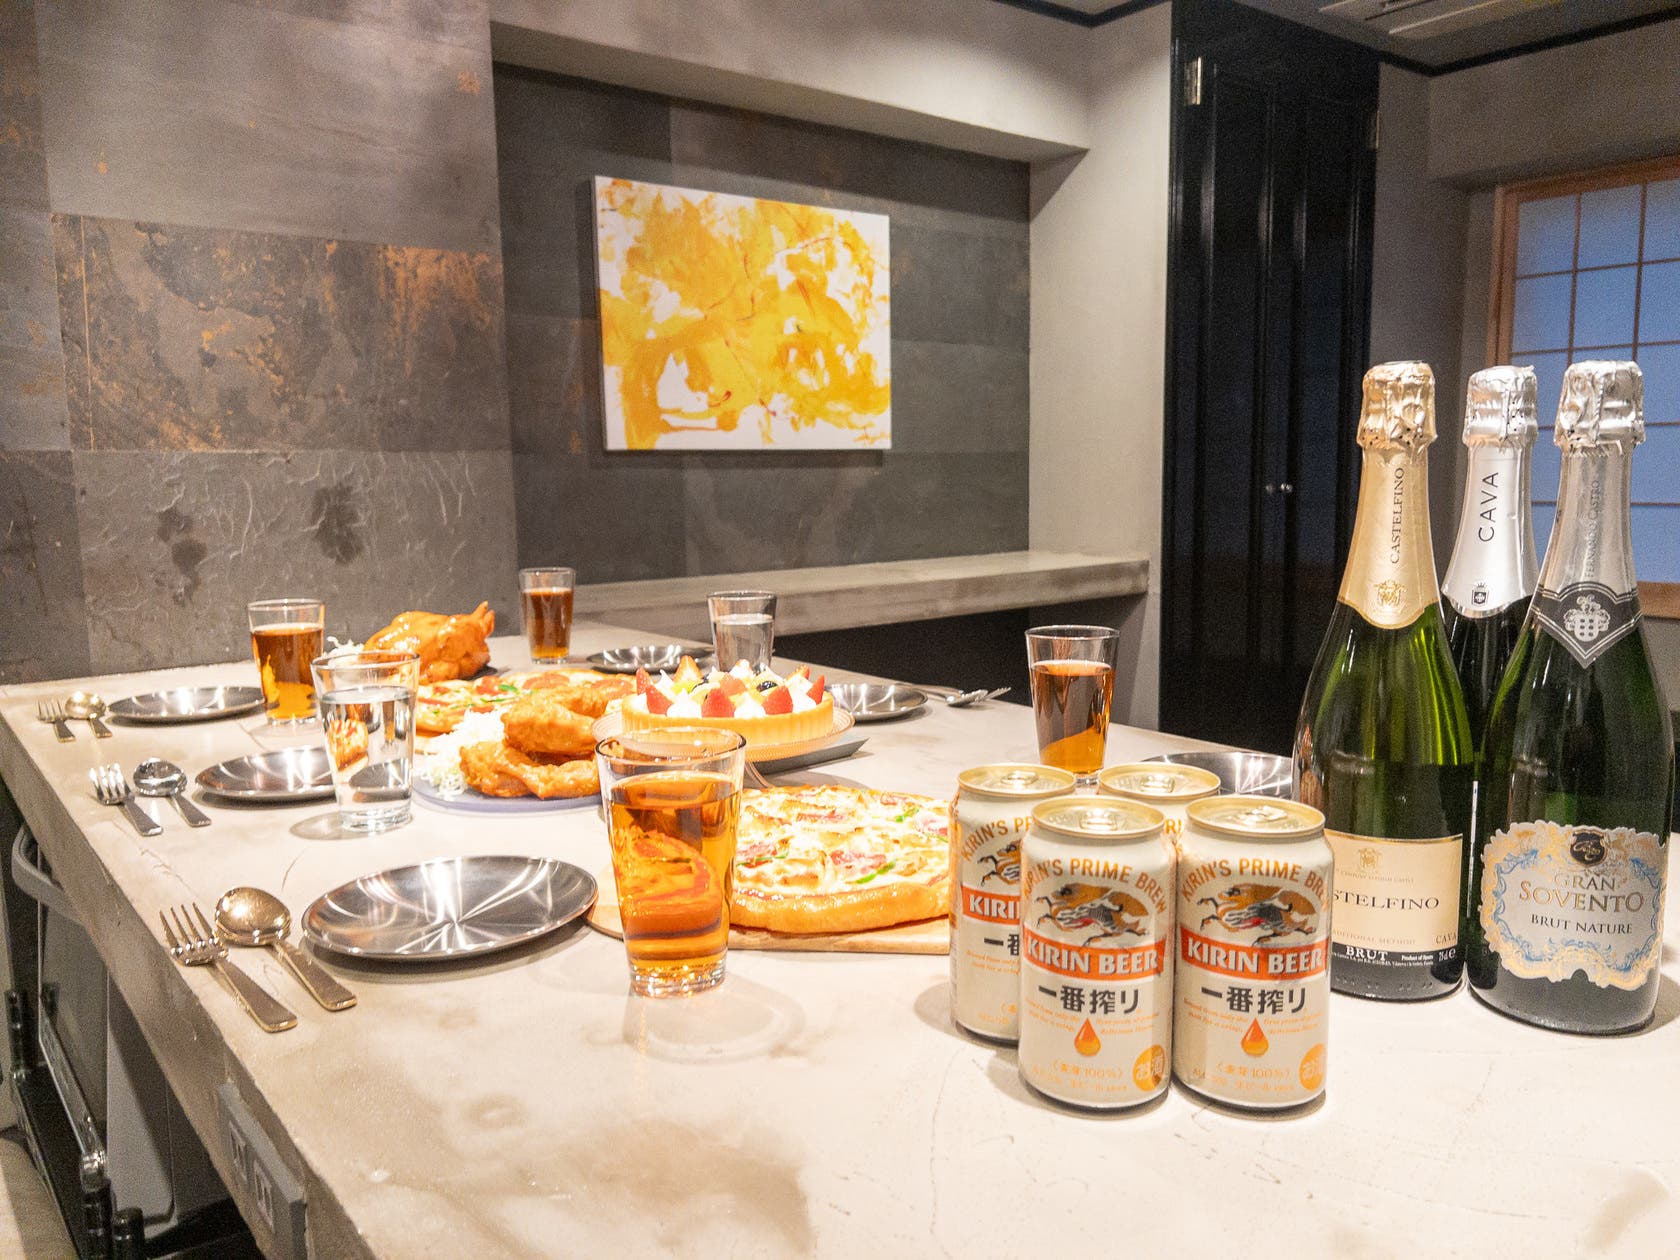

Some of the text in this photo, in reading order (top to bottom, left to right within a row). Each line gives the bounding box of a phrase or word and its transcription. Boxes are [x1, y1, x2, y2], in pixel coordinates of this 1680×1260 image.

[1390, 467, 1404, 564] CASTELFINO
[1478, 472, 1499, 542] CAVA
[1588, 480, 1601, 519] CASTRO
[961, 820, 1008, 862] KIRIN'S
[1070, 858, 1133, 883] PRIME
[1134, 872, 1168, 914] BREW
[1181, 860, 1232, 901] KIRIN'S
[1239, 858, 1302, 883] PRIME
[1519, 880, 1645, 913] SOVENTO
[1554, 872, 1616, 892] GRAN
[969, 895, 1021, 918] KIRI
[1531, 914, 1633, 934] BRUT NATURE
[1027, 935, 1091, 974] KIRIN
[1098, 949, 1159, 975] BEER
[1187, 938, 1323, 974] KIRIN BEER
[1345, 945, 1388, 961] BRUT
[1038, 985, 1139, 1015] 一番搾り
[1201, 986, 1306, 1015] 一番搾り
